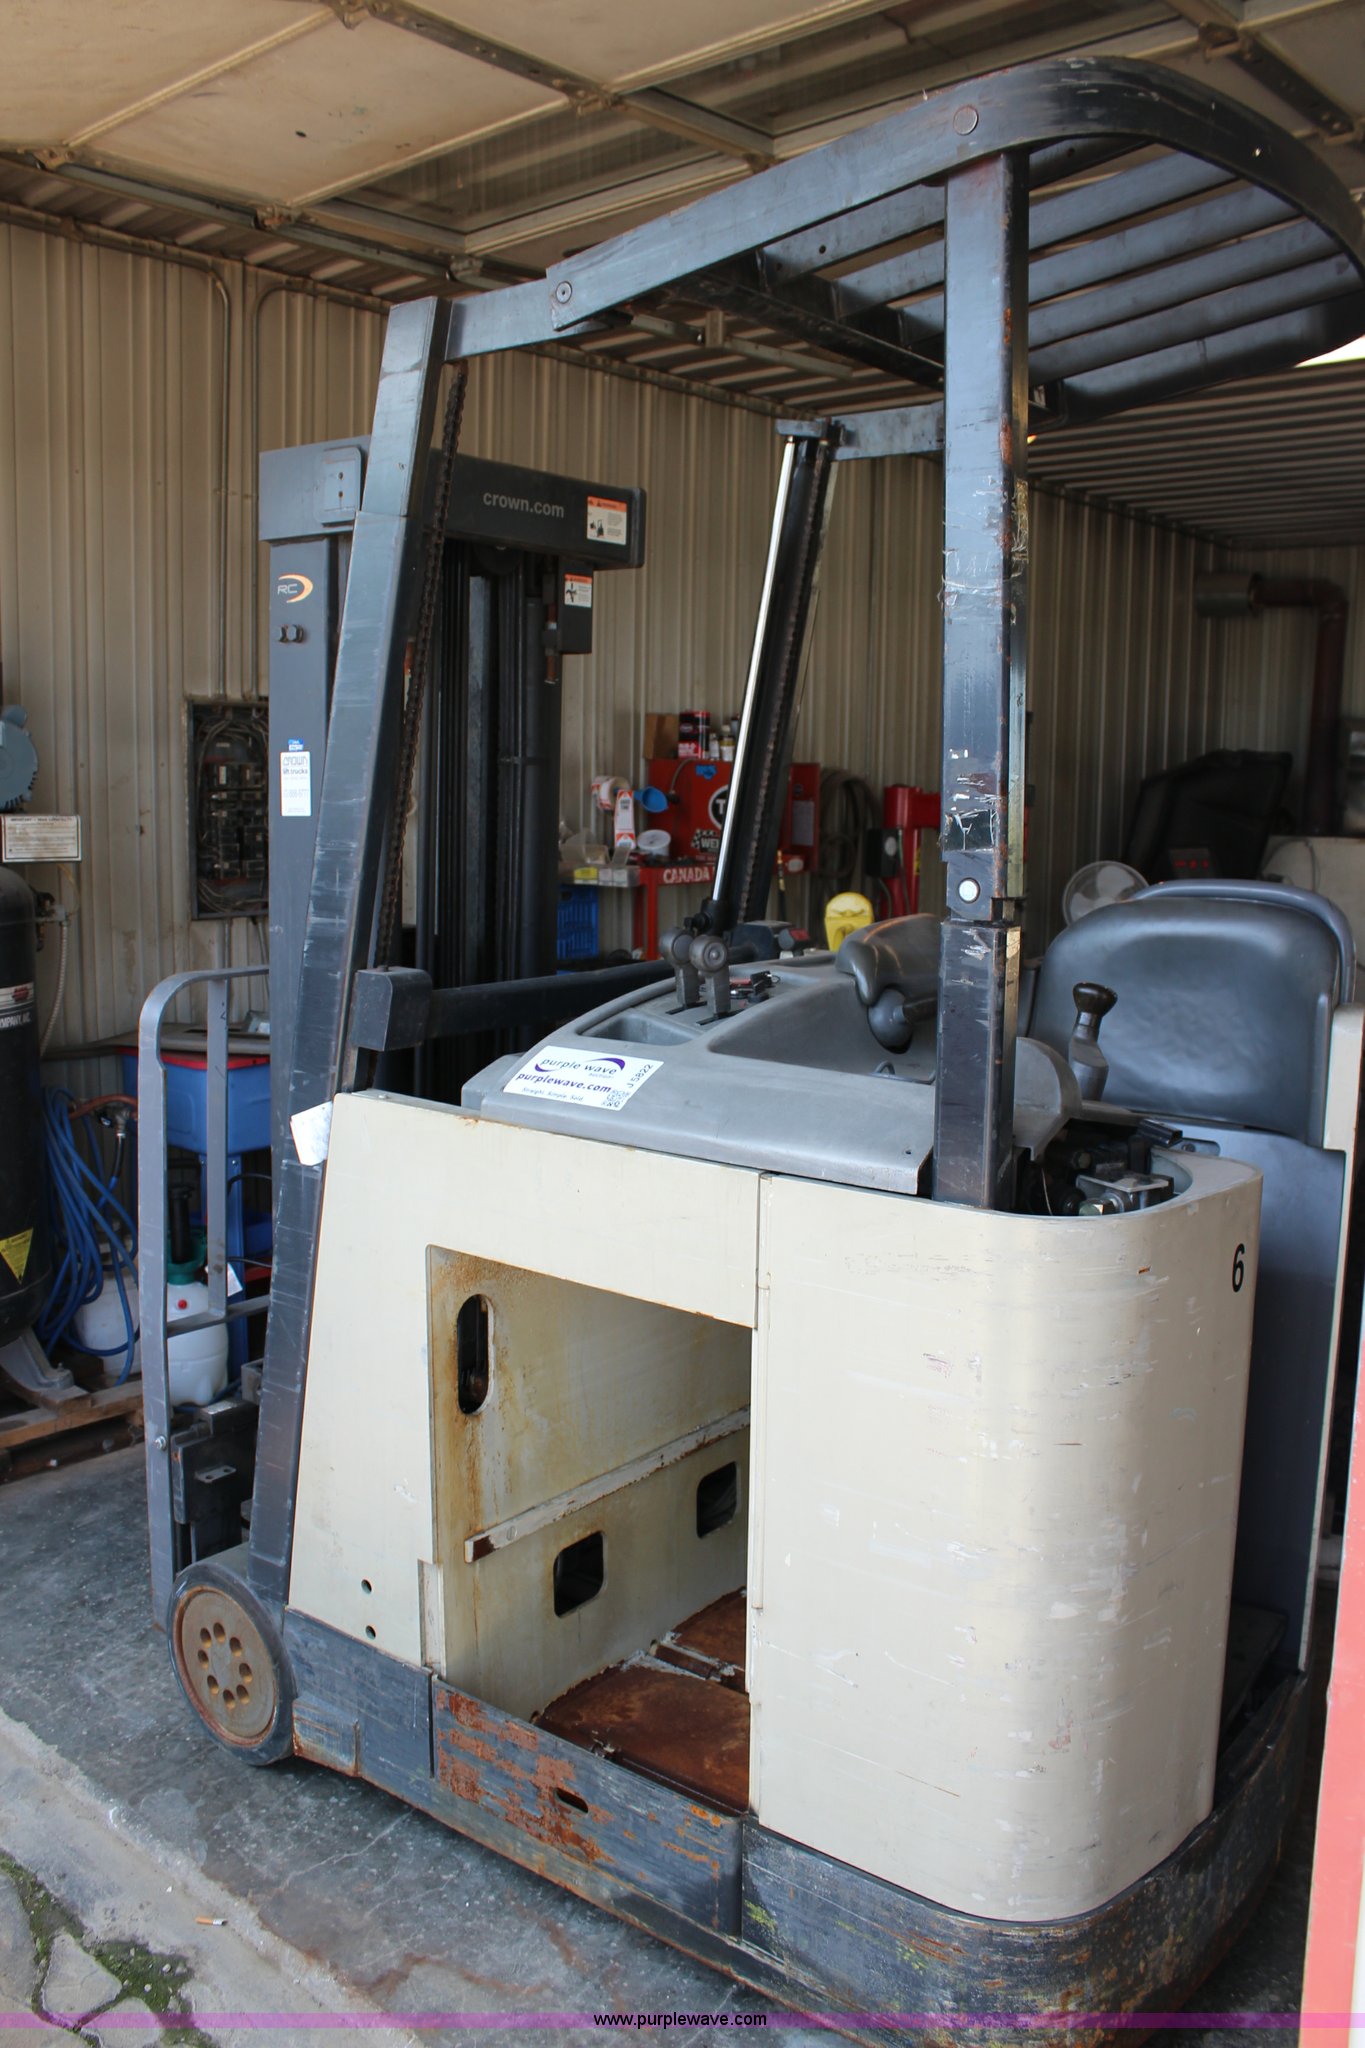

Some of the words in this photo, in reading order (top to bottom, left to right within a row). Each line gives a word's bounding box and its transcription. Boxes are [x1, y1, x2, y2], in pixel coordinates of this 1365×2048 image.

[483, 492, 564, 518] crown.com
[277, 583, 297, 594] RC
[663, 867, 710, 884] CANADA
[541, 1057, 581, 1070] purple
[585, 1064, 617, 1075] wave
[516, 1072, 612, 1093] purplewave.com
[1232, 1243, 1245, 1293] 6
